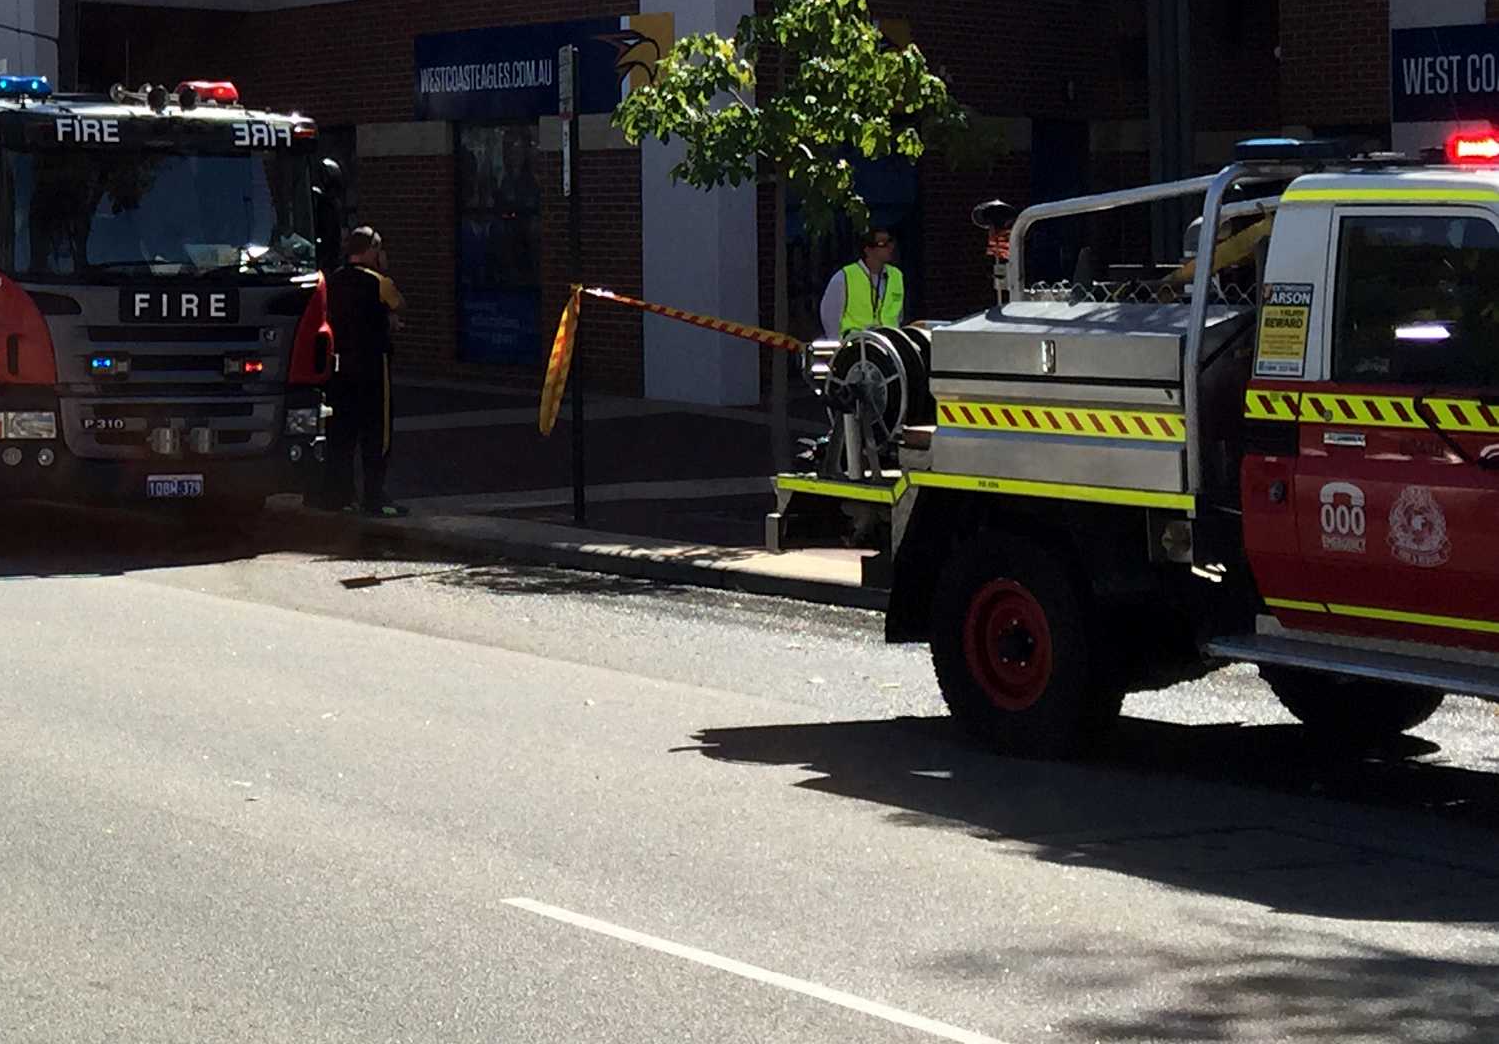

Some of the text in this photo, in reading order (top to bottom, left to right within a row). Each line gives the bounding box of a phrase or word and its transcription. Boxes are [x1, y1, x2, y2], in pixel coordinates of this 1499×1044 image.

[420, 59, 552, 93] WESTCOASTEAGLES.COM.AU
[1403, 53, 1499, 95] WEST CO
[56, 118, 120, 143] FIRE
[134, 293, 227, 317] FIRE
[1270, 292, 1311, 304] ARSON
[1264, 318, 1304, 329] REWARD
[84, 419, 124, 429] P 310
[1321, 504, 1366, 536] 000
